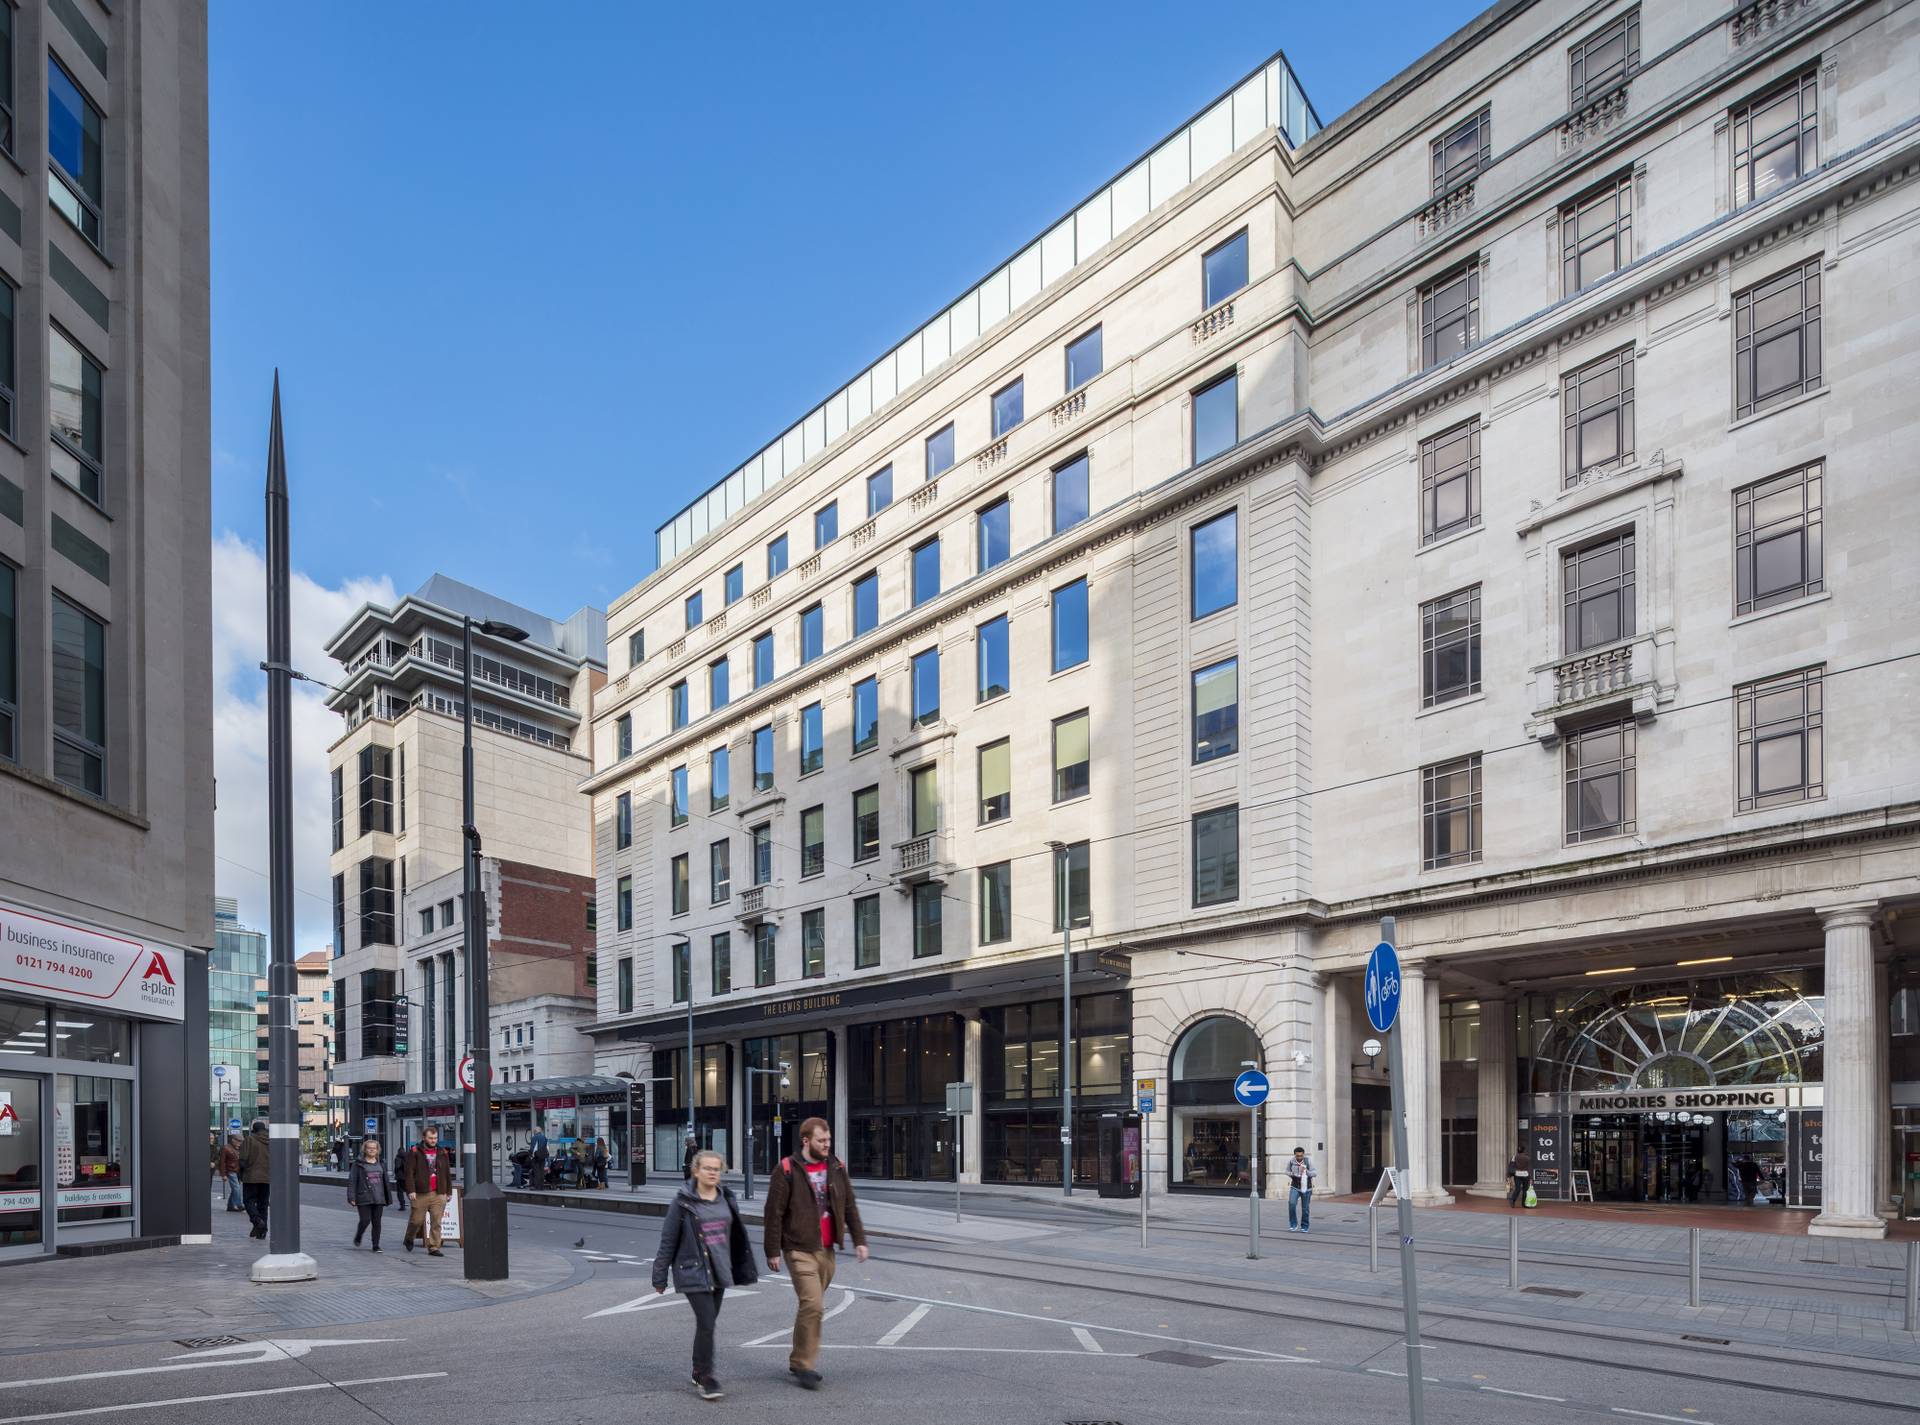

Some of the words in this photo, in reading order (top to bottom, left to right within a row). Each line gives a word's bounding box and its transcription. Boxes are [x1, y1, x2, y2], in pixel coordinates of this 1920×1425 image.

[7, 926, 58, 952] business
[61, 940, 115, 965] insurance
[16, 954, 42, 969] 0121
[46, 960, 65, 974] 794
[68, 966, 93, 980] 4200
[141, 980, 175, 997] a-plan
[141, 994, 175, 1007] insurance
[396, 998, 407, 1007] 42
[763, 1006, 776, 1016] THE
[779, 1001, 800, 1013] LEWIS
[804, 995, 840, 1009] BUILDING
[1579, 1095, 1666, 1110] MINORIES
[1674, 1092, 1775, 1108] SHOPPING
[1534, 1124, 1558, 1133] shops
[1538, 1137, 1553, 1147] to
[1536, 1150, 1555, 1161] let
[1809, 1150, 1823, 1162] le
[18, 1197, 34, 1205] 4200
[64, 1194, 91, 1203] buildings
[98, 1192, 122, 1201] contents
